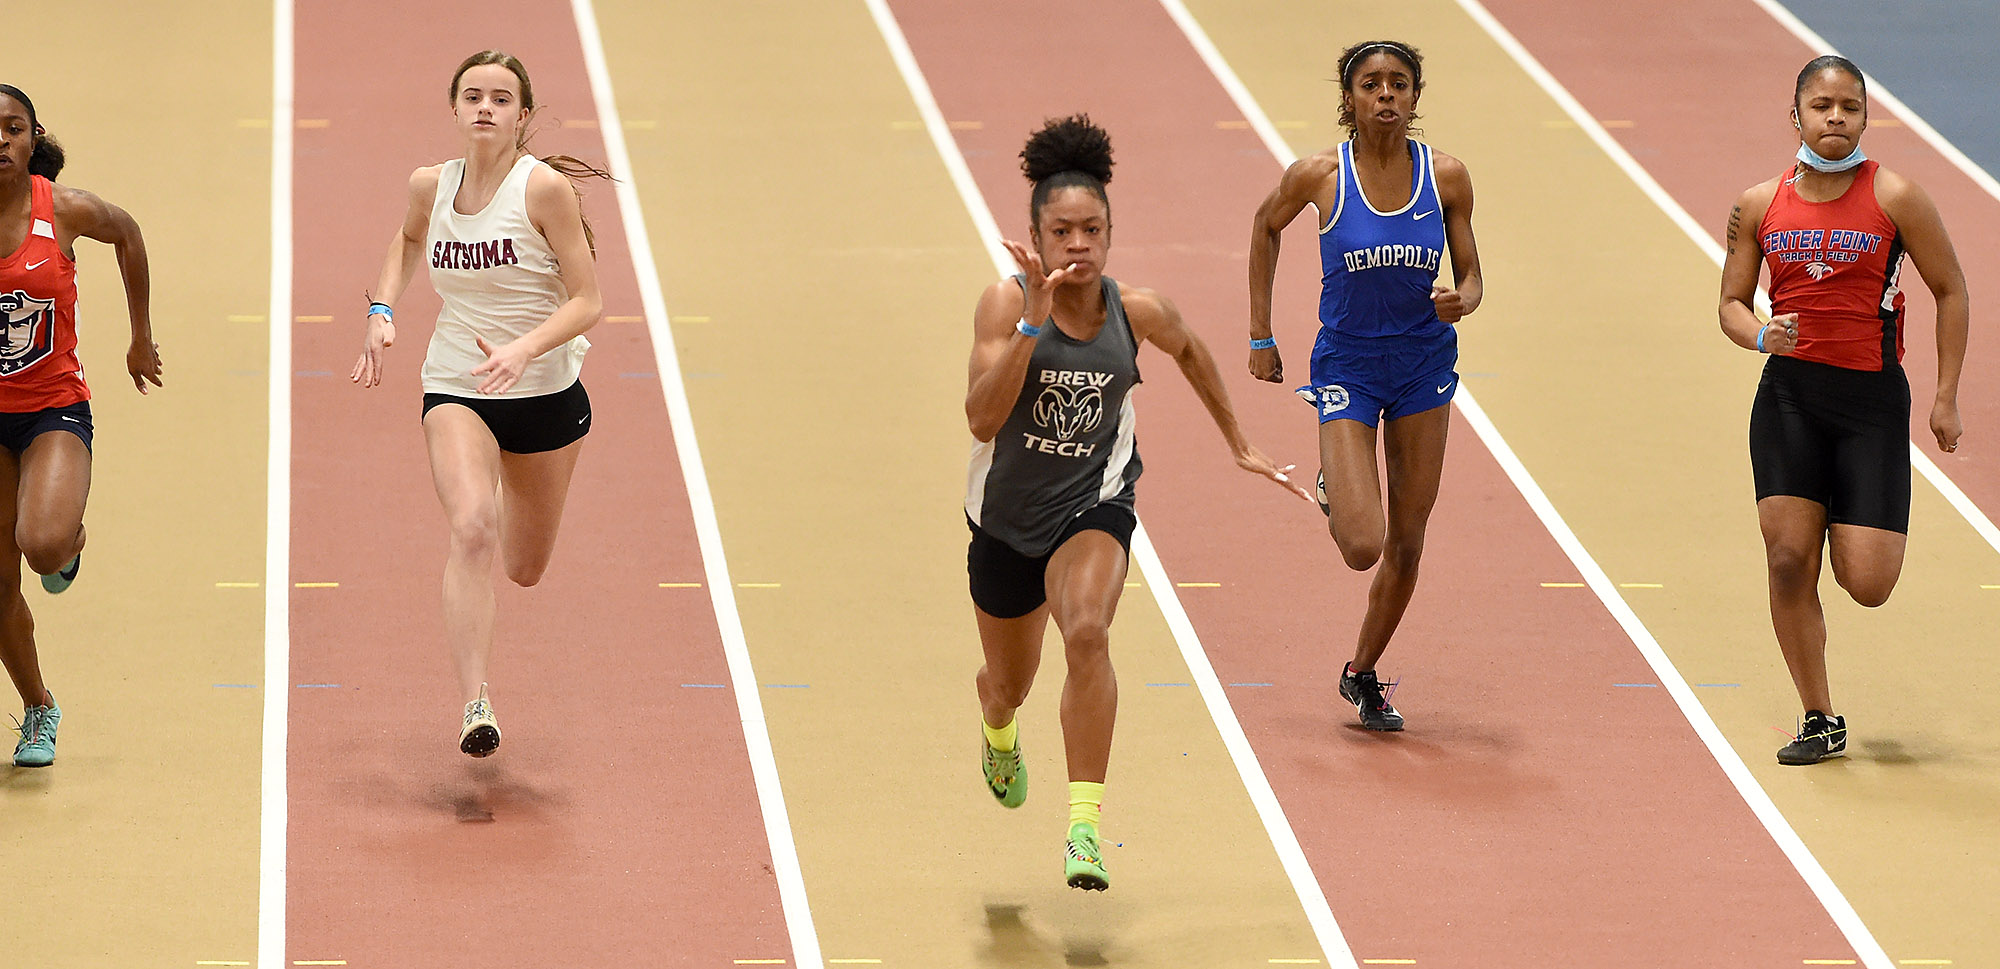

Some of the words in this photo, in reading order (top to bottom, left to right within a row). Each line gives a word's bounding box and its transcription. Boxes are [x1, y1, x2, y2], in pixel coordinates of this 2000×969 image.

[431, 238, 519, 271] SATSUMA
[1763, 229, 1825, 256] CENTER
[1828, 229, 1883, 254] POINT
[1343, 244, 1440, 273] DEMOPOLIS
[1778, 251, 1812, 263] TRACK
[1814, 250, 1823, 262] &
[1826, 251, 1860, 263] FIELD
[1039, 369, 1115, 387] BREW
[1023, 432, 1096, 457] TECH
